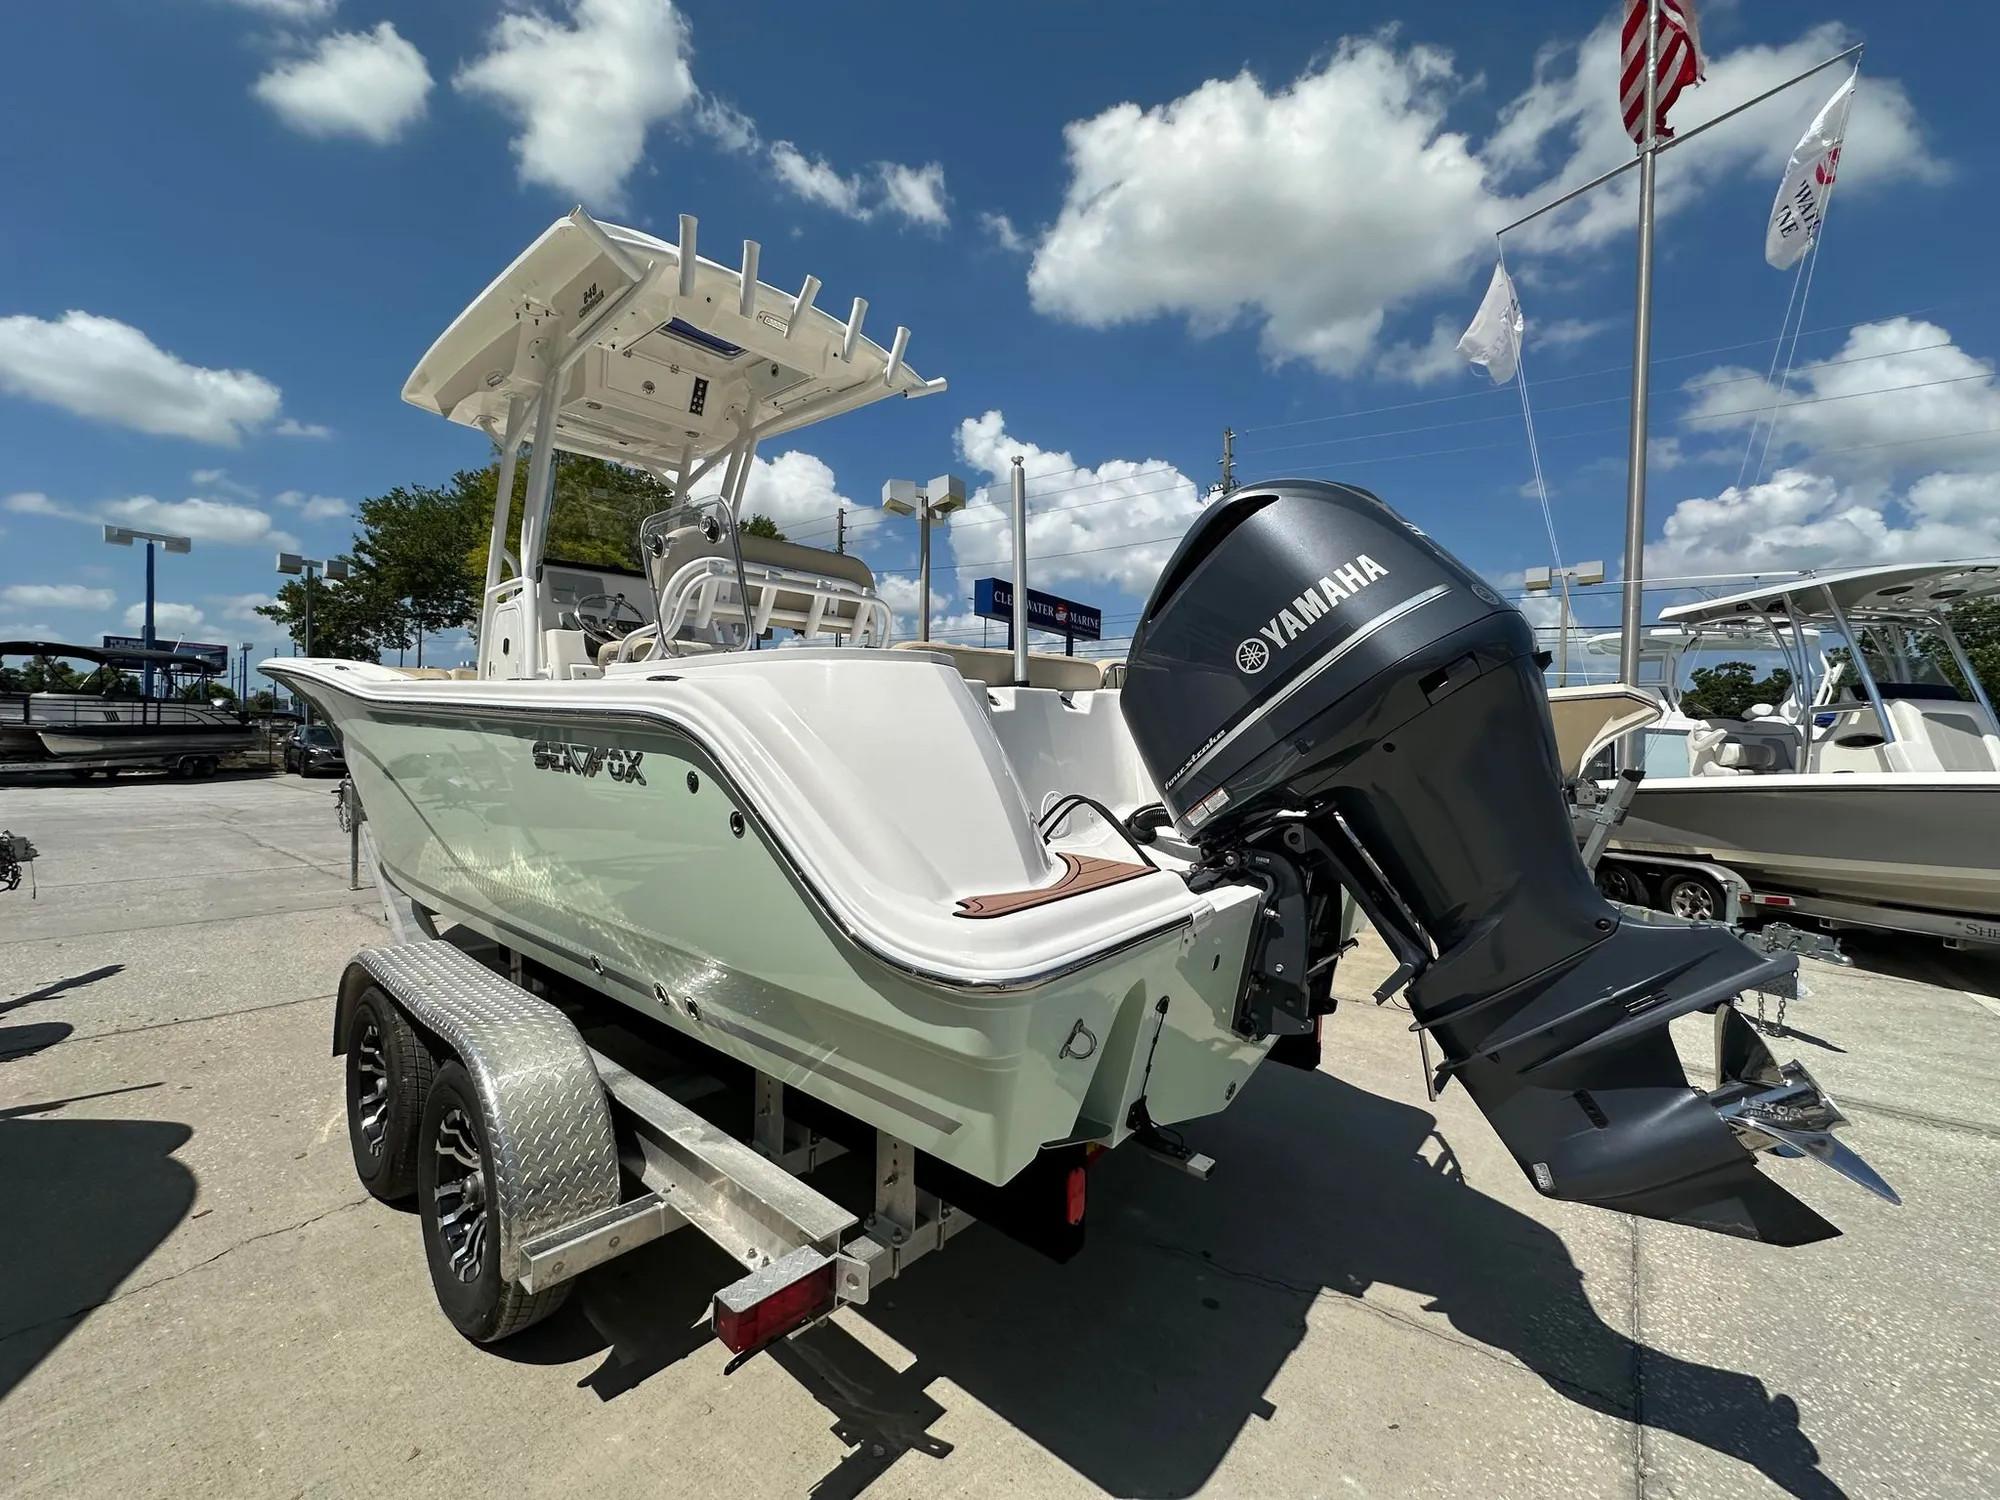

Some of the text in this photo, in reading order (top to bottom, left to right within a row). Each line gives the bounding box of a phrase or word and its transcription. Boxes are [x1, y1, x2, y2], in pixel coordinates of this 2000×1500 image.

[994, 590, 1099, 629] CLEWATER MARINE
[1259, 554, 1390, 649] YAMAHA
[1165, 729, 1226, 790] fourstroke
